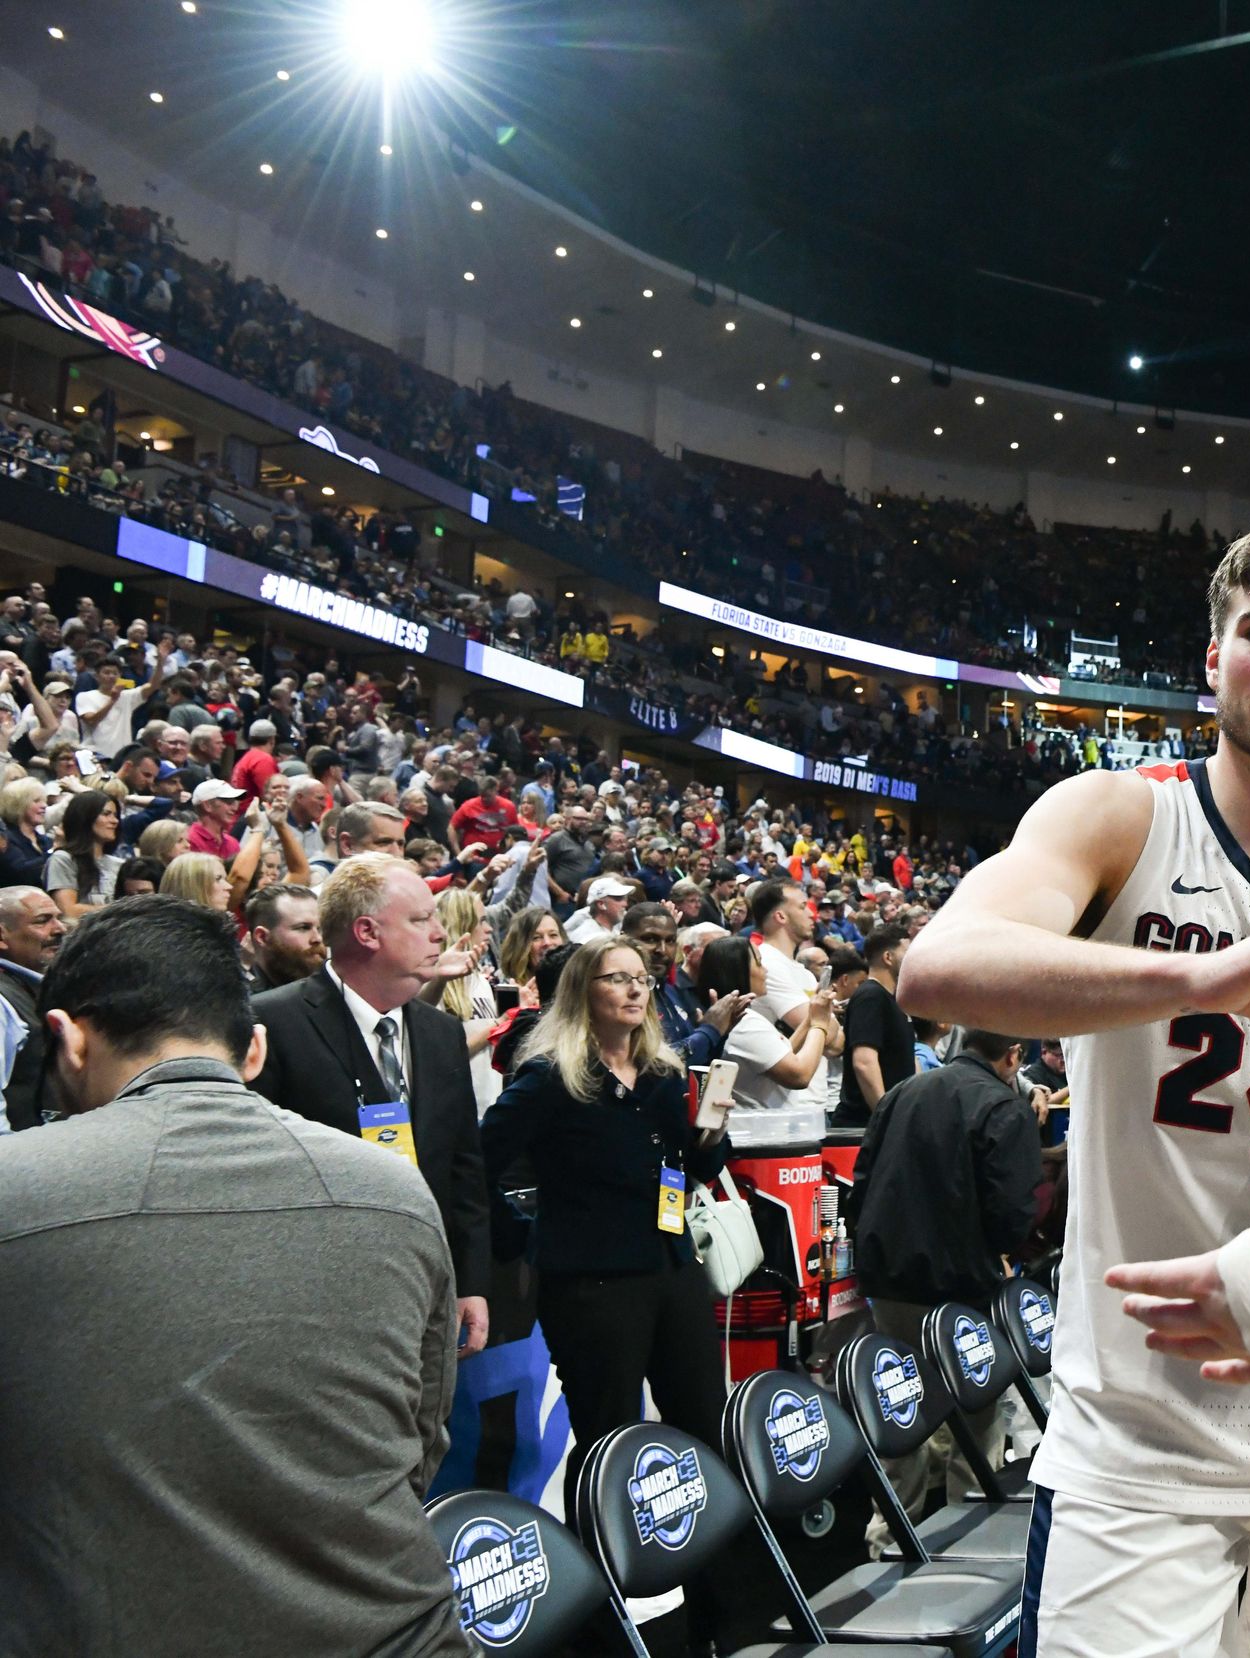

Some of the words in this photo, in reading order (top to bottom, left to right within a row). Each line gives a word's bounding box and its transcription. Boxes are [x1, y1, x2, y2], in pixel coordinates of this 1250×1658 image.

[260, 573, 430, 654] #MARCHMADNESS
[711, 603, 751, 628] FLORIDA
[753, 617, 780, 637] STATE
[782, 626, 796, 641] VS
[799, 630, 847, 652] GONZAGA
[630, 697, 666, 730] ELITE
[669, 706, 678, 729] 8
[814, 761, 842, 786] 2019
[842, 767, 856, 789] DI
[958, 1331, 980, 1353] MARCH
[965, 1341, 994, 1366] MADNESS
[879, 1365, 905, 1391] MARCH
[887, 1376, 922, 1405] MADNESS
[774, 1409, 807, 1439] MARCH
[784, 1420, 828, 1456] MADNESS
[639, 1464, 680, 1501] MARCH
[650, 1477, 705, 1521] MADNESS
[457, 1542, 513, 1589] MARCH
[471, 1556, 546, 1612] MADNESS
